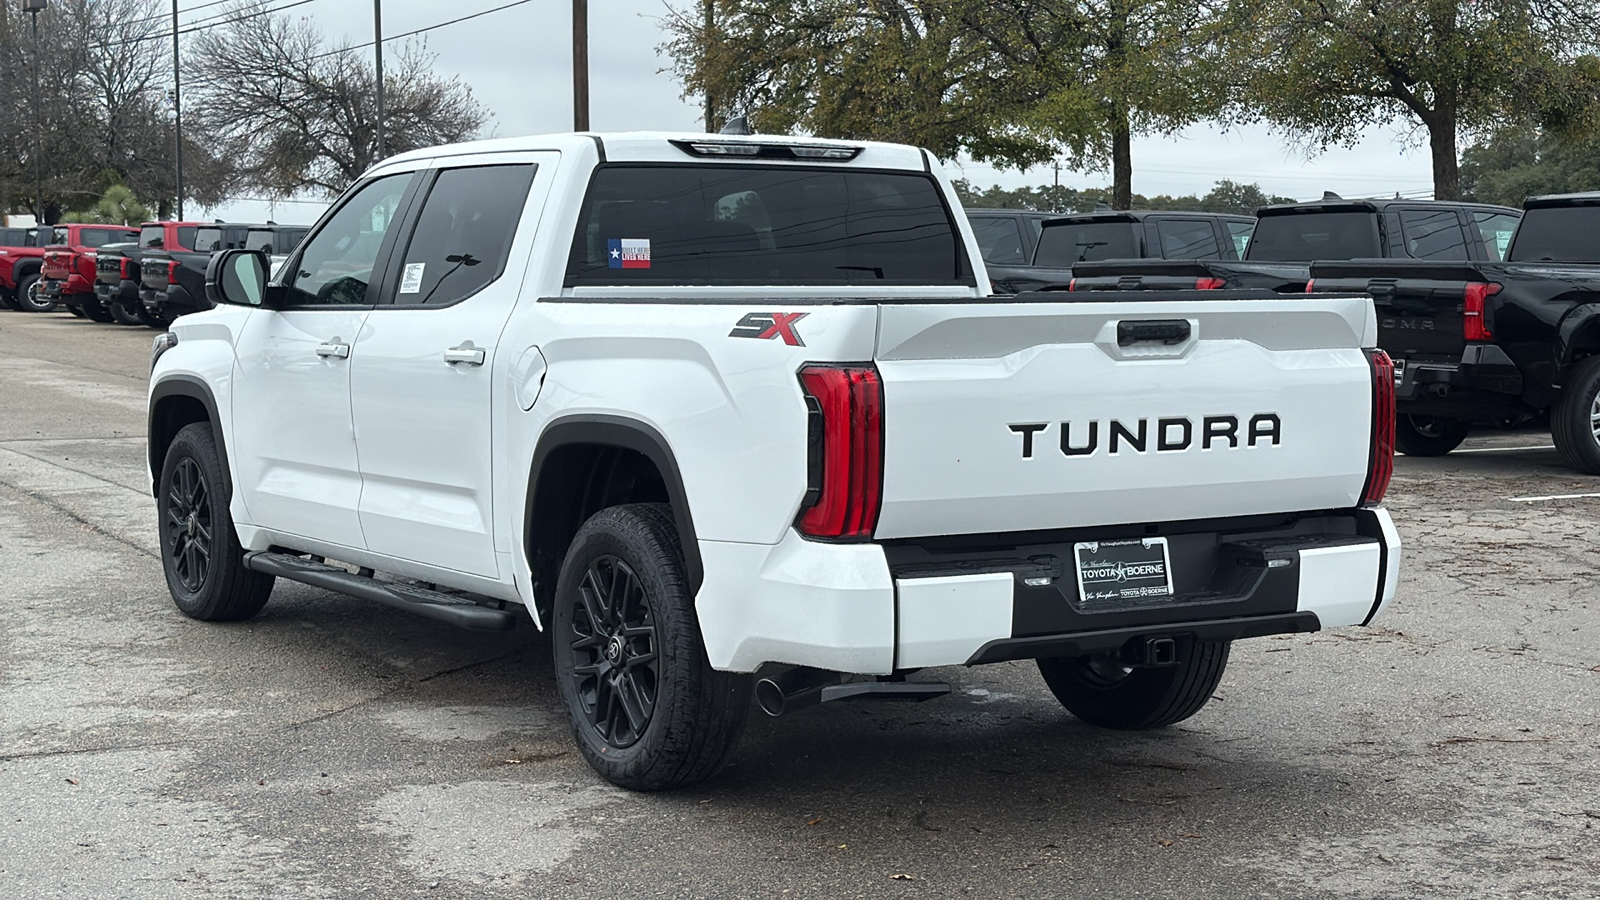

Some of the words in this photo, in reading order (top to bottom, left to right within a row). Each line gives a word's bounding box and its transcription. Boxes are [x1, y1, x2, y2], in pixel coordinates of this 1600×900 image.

[1006, 412, 1281, 460] TUNDRA
[1082, 568, 1116, 579] TOYOTA
[1127, 564, 1164, 576] BOERNE
